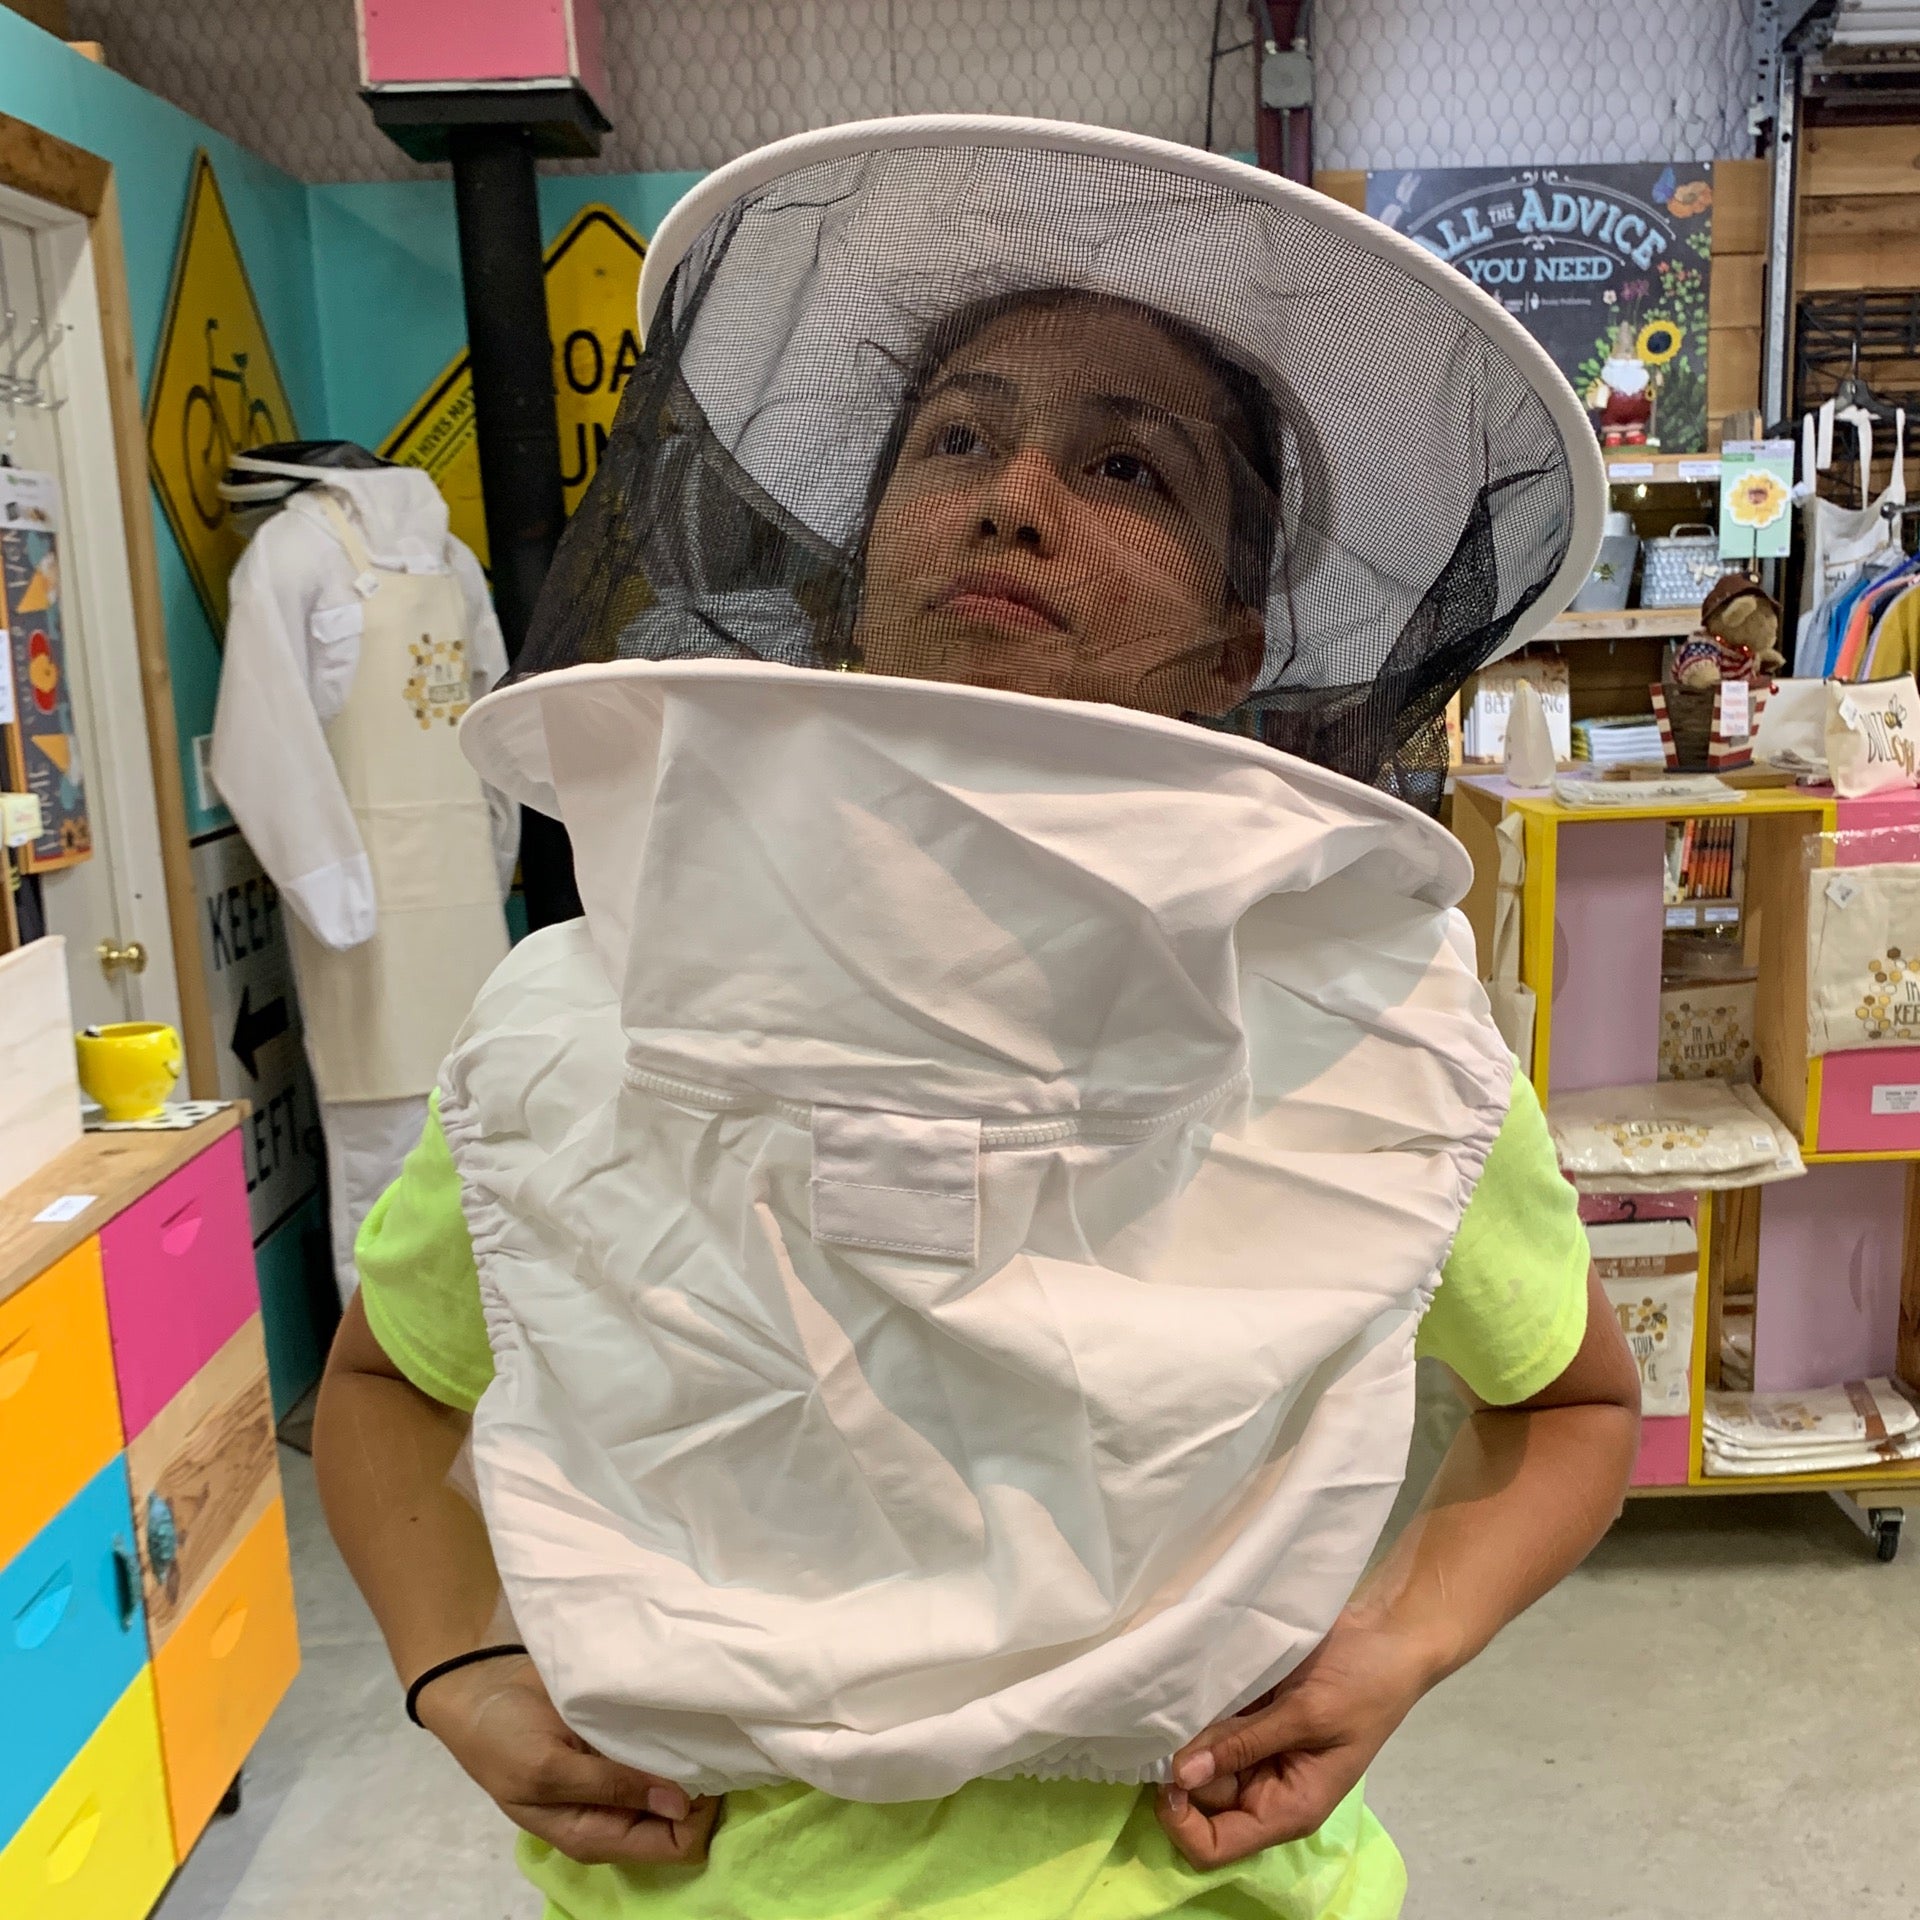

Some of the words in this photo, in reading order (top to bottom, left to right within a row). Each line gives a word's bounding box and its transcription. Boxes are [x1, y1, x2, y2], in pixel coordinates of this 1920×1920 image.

[1465, 258, 1528, 284] YOU
[1534, 256, 1614, 283] NEED
[1488, 205, 1515, 226] THE
[1516, 187, 1668, 271] ADVICE
[206, 874, 281, 971] KEEP
[1893, 1004, 1920, 1027] KEE
[246, 1083, 299, 1194] EFT
